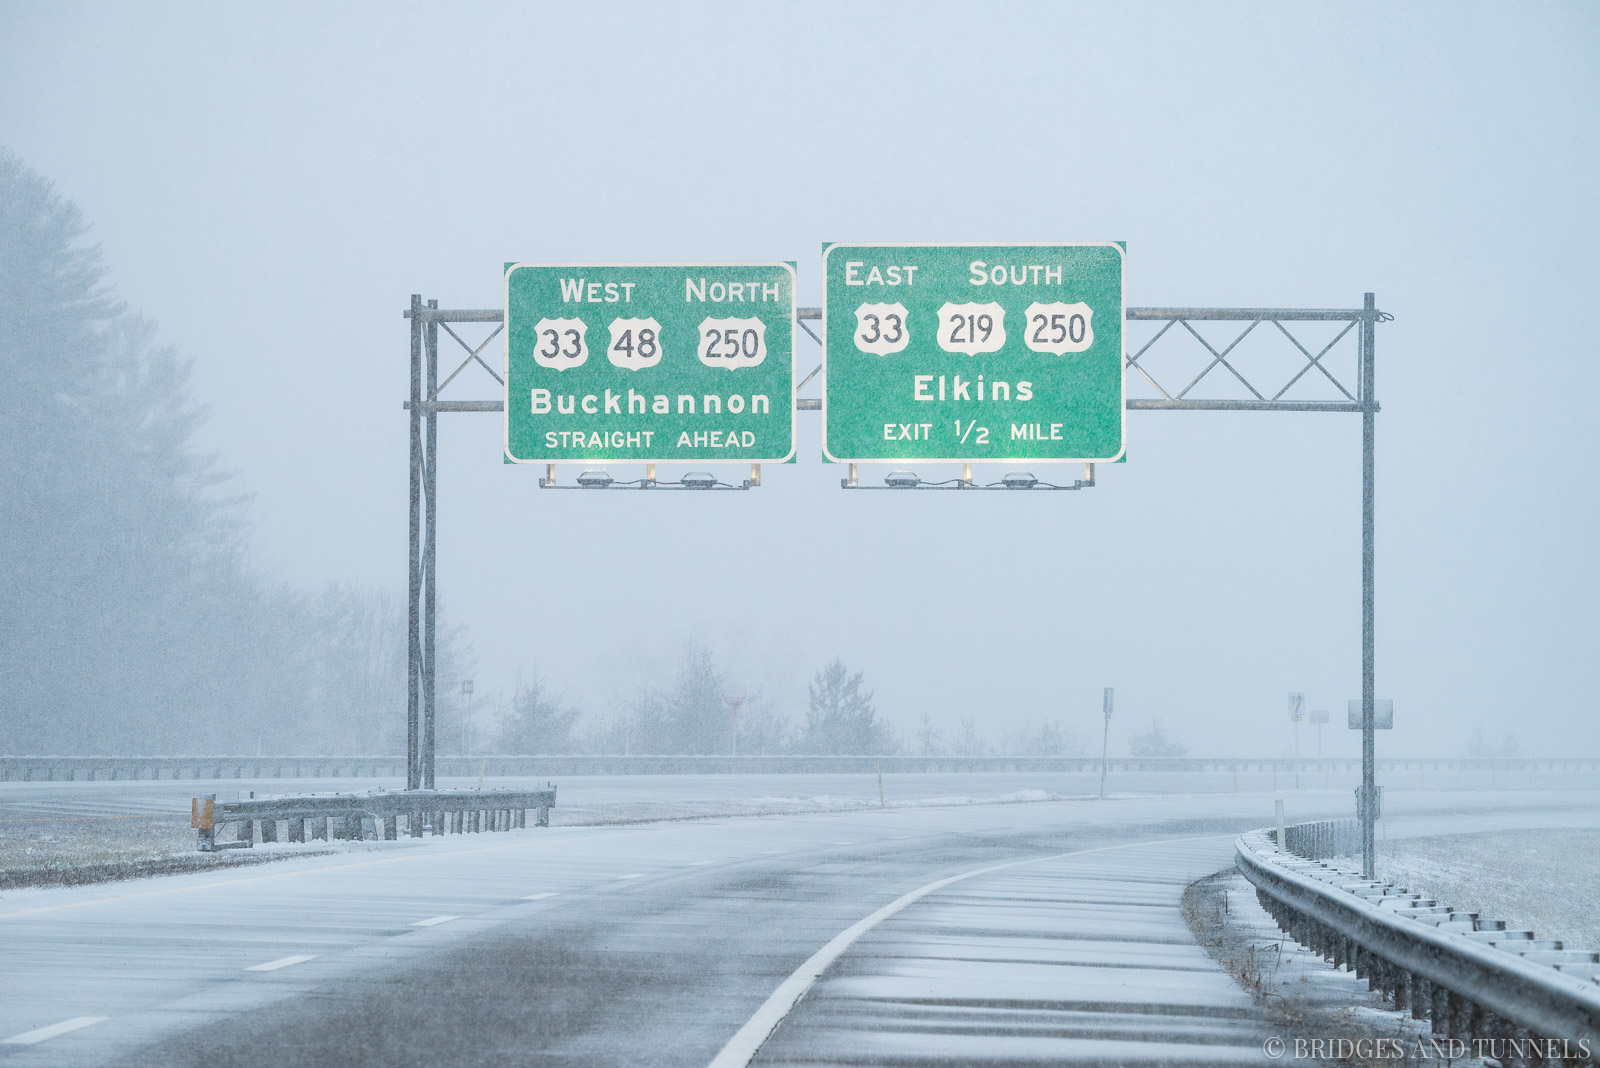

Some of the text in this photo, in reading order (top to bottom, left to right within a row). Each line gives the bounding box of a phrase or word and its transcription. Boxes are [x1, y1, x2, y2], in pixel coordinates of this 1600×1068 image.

[845, 261, 1063, 286] EAST SOUTH
[560, 278, 779, 303] WEST NORTH
[613, 328, 657, 358] 48
[705, 328, 759, 358] 250
[860, 313, 903, 344] 33
[949, 313, 994, 344] 219
[1032, 313, 1086, 344] 250
[540, 328, 582, 359] 33
[530, 387, 770, 415] Buckhannon
[914, 374, 1034, 402] Elkins
[544, 430, 756, 448] STRAIGHT AHEAD
[883, 419, 1064, 445] EXIT 1/2 MILE
